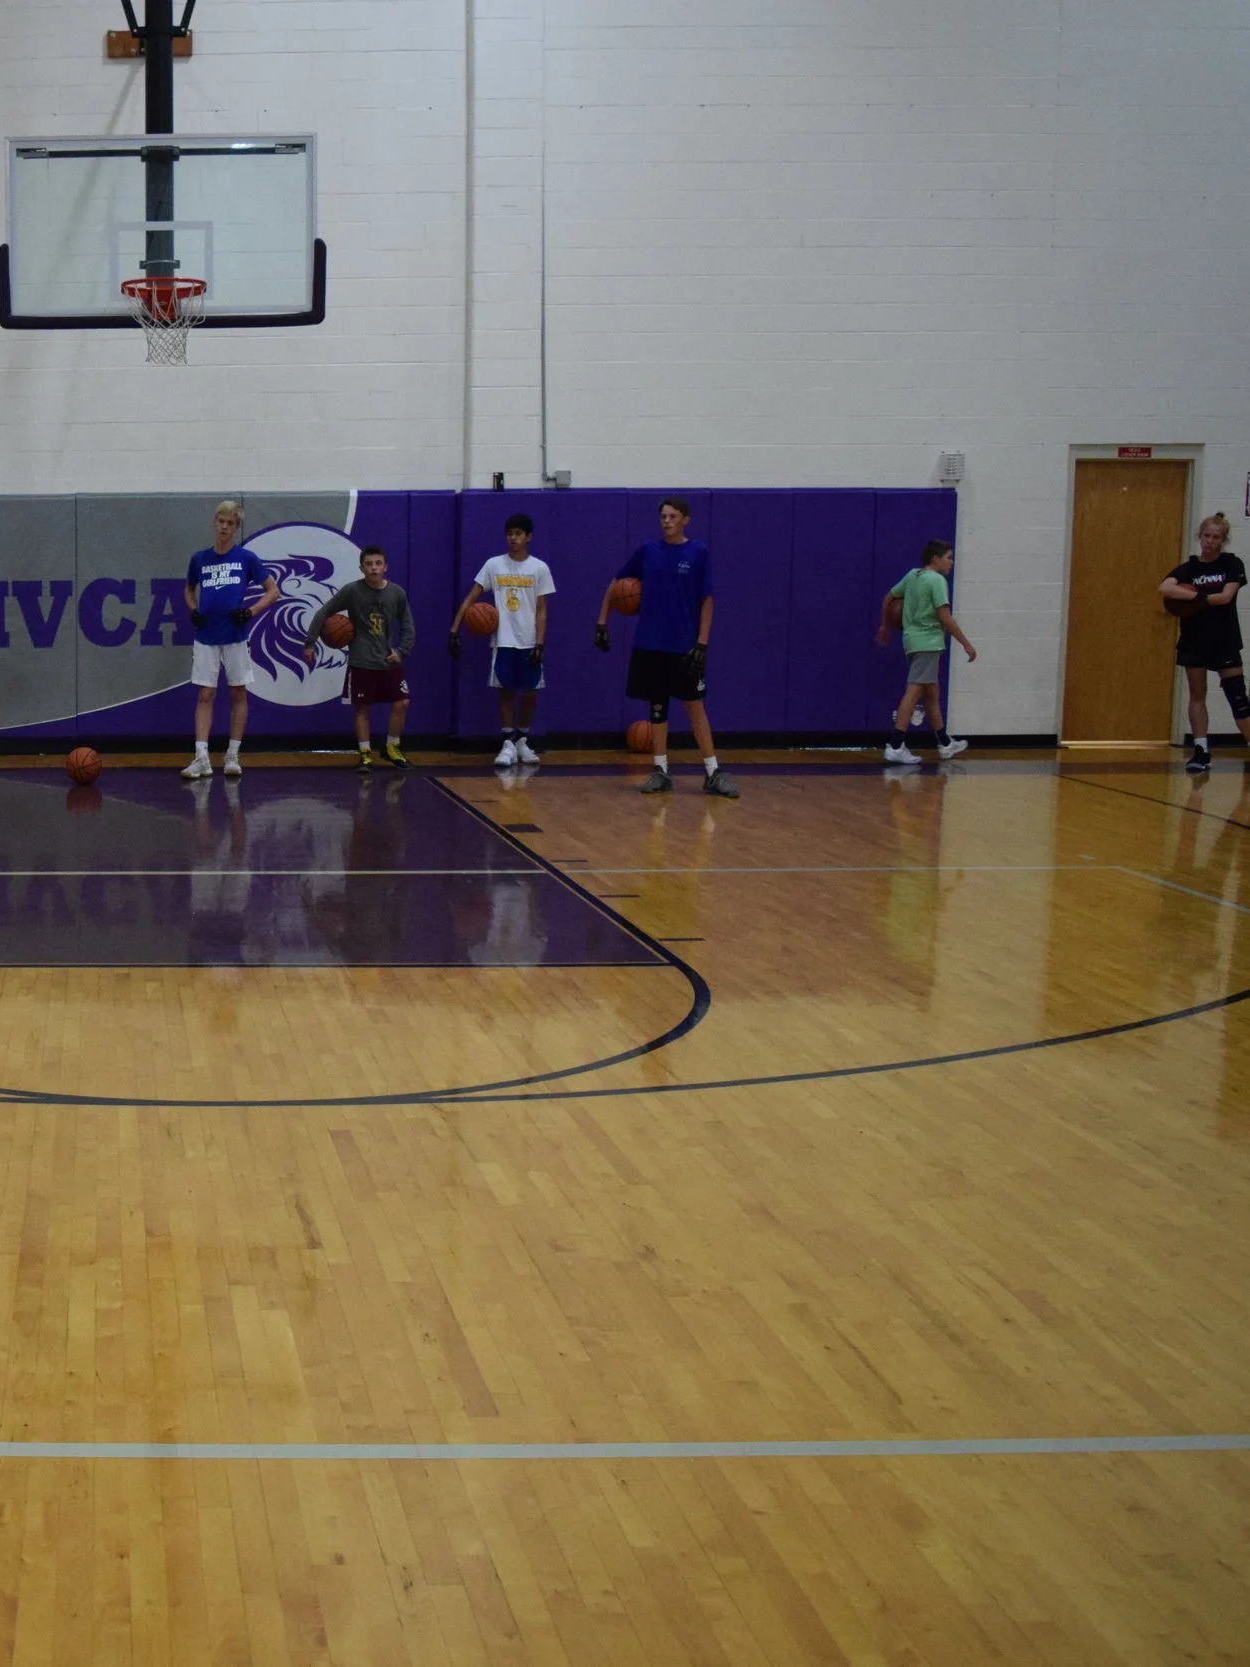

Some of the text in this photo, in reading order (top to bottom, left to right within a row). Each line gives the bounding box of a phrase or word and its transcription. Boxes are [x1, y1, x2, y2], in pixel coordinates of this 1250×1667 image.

[201, 562, 242, 574] BASKETBALL
[211, 570, 230, 579] IS MY
[202, 576, 241, 588] GIRLFRIEND
